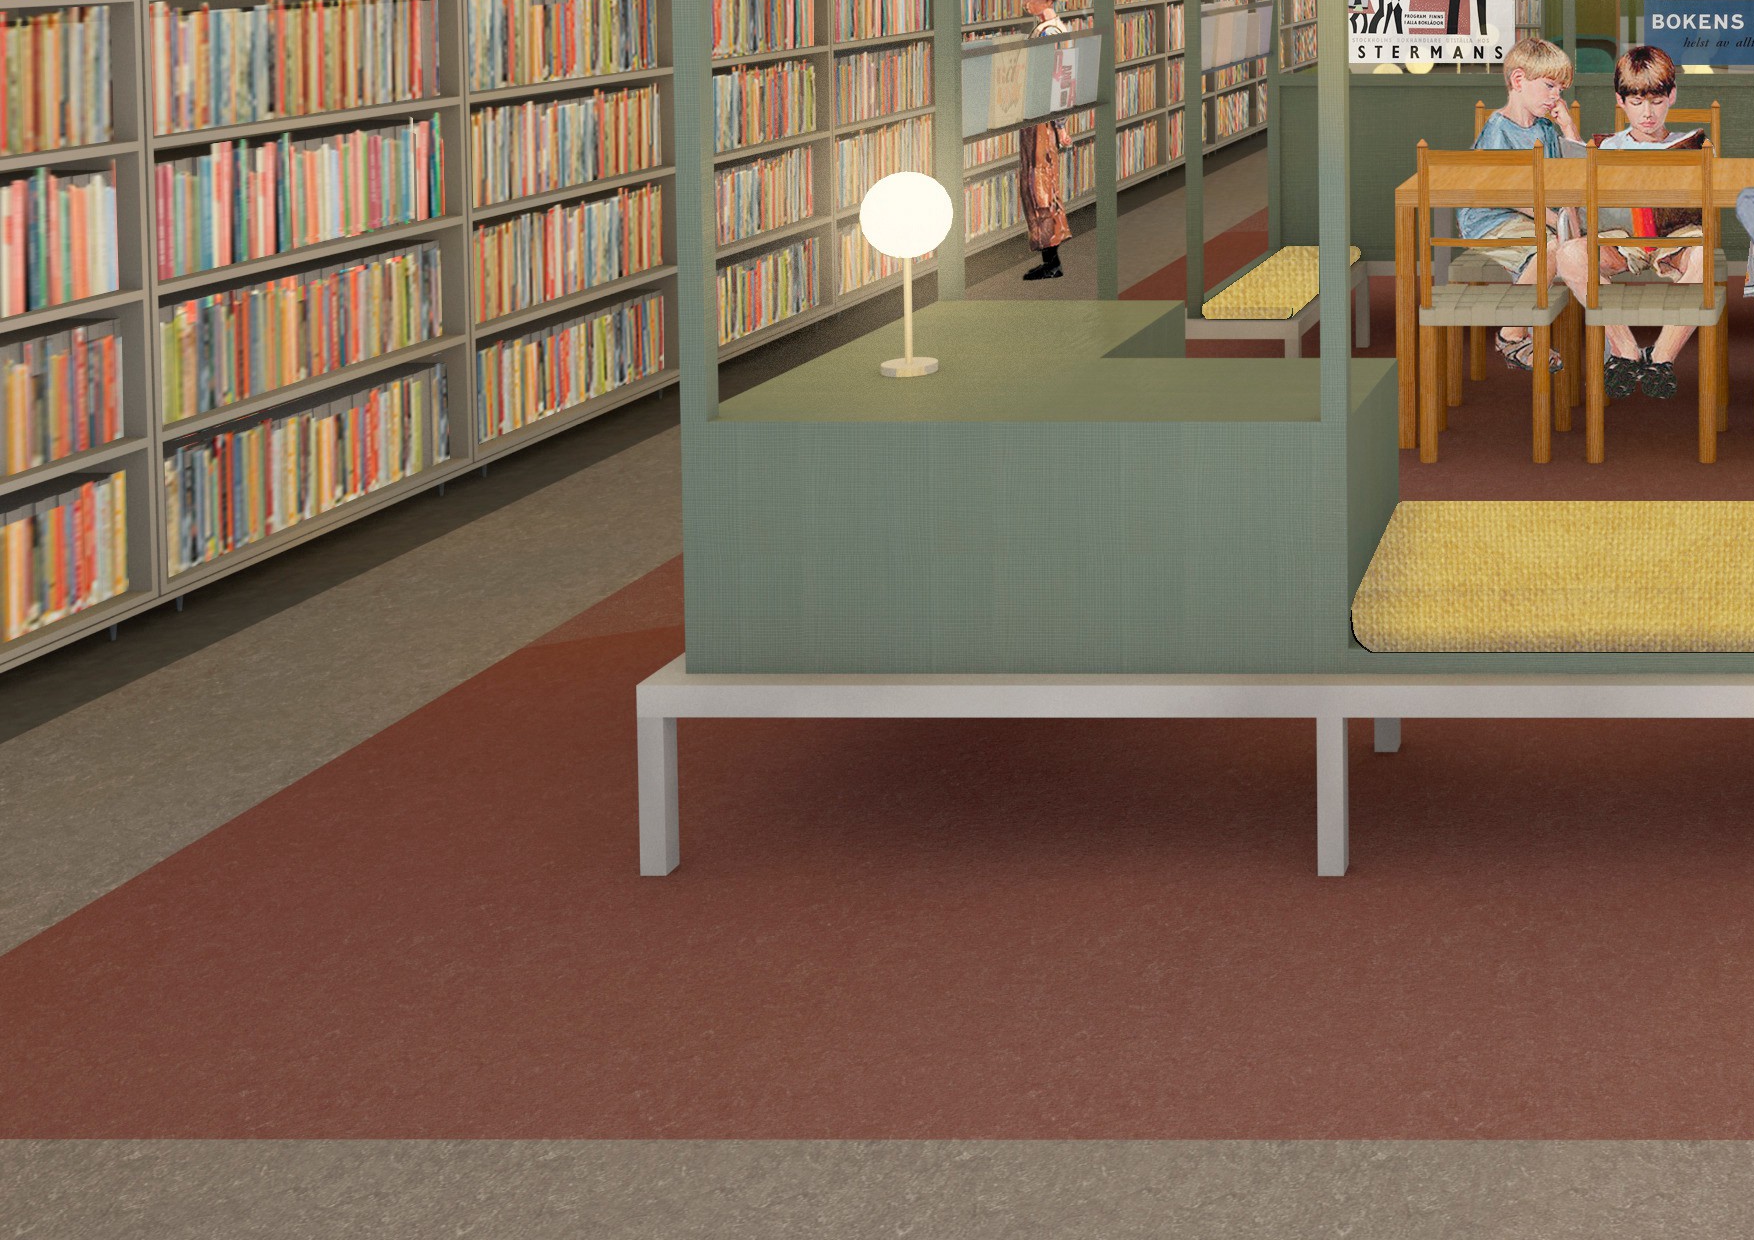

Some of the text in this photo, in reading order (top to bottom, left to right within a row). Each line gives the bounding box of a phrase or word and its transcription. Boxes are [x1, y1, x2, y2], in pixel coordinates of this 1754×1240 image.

[1652, 13, 1745, 30] BOKENS
[1683, 36, 1710, 49] helst
[1715, 39, 1730, 48] av
